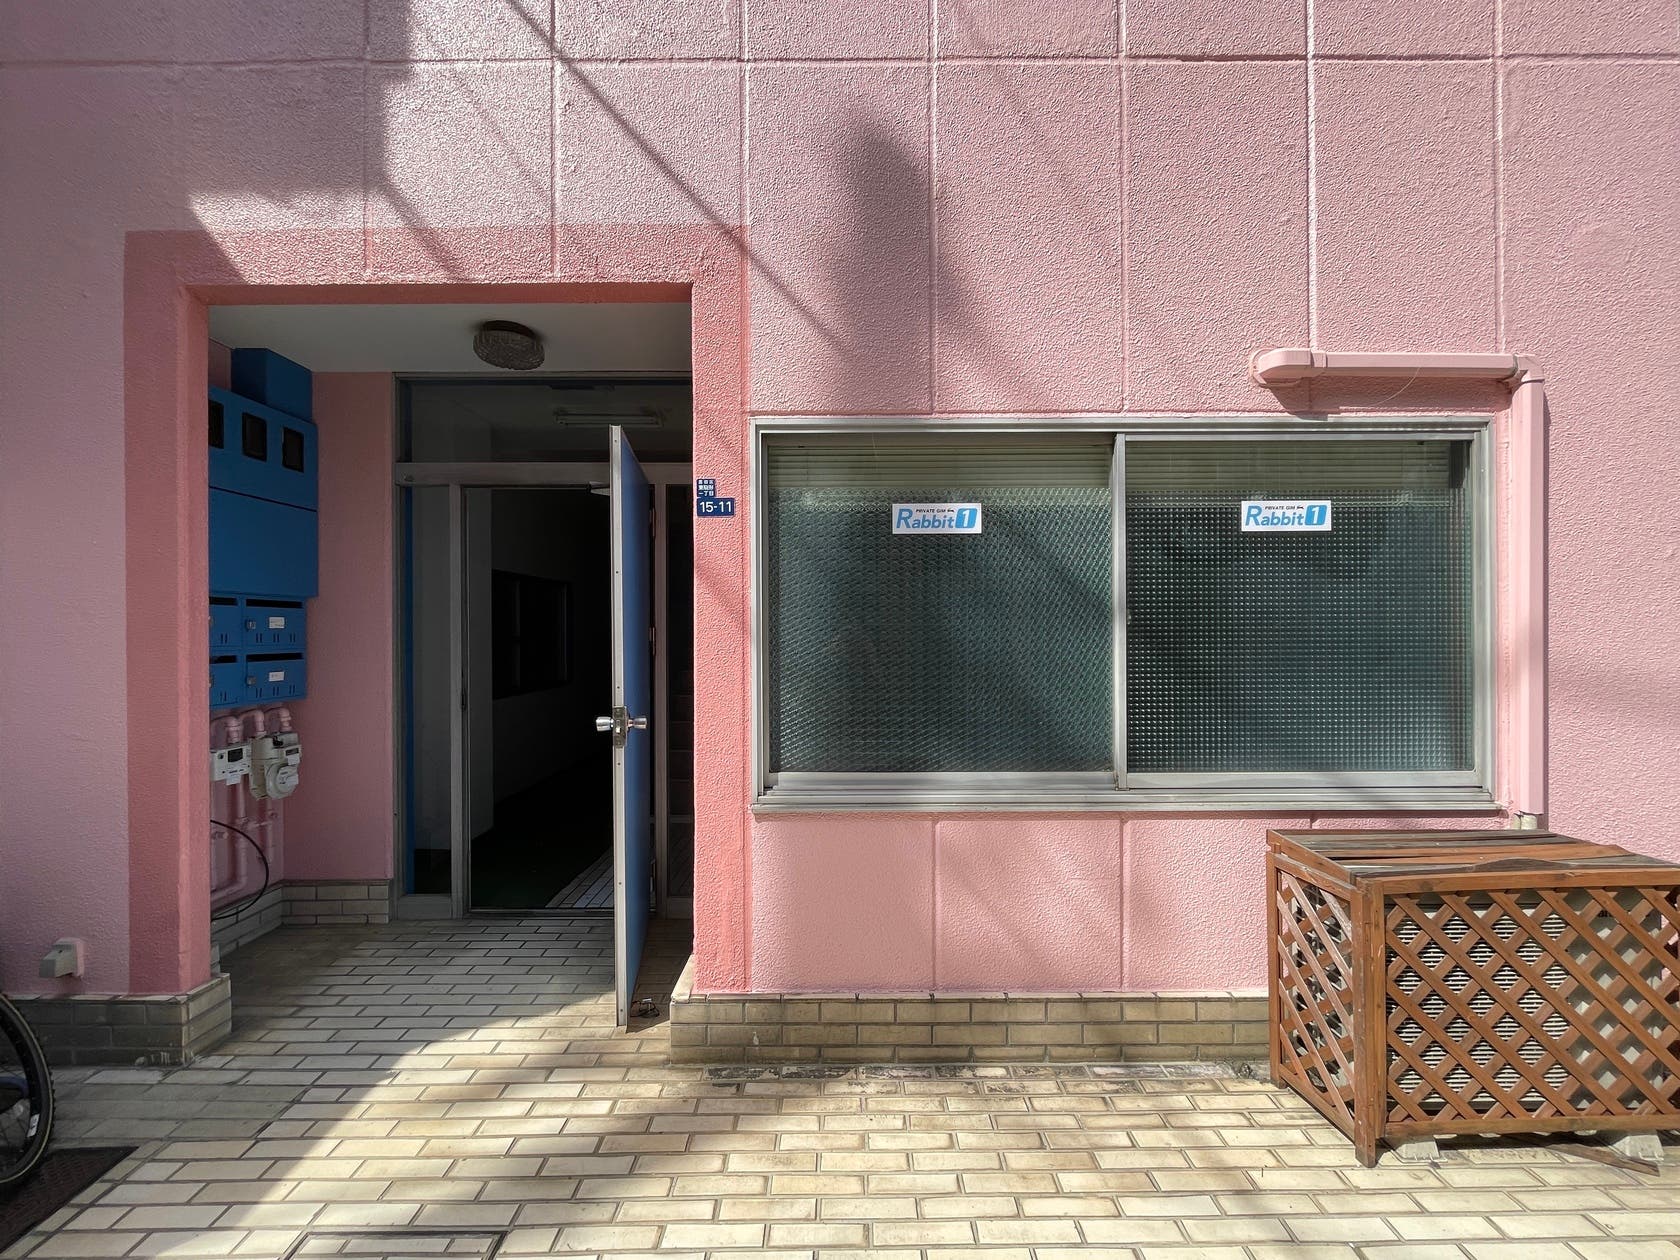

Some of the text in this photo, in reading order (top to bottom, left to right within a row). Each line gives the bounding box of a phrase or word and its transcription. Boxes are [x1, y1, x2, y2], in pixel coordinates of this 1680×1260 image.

[700, 501, 732, 513] 15-11
[1245, 505, 1304, 526] Rabbit
[896, 508, 955, 529] Rabbit
